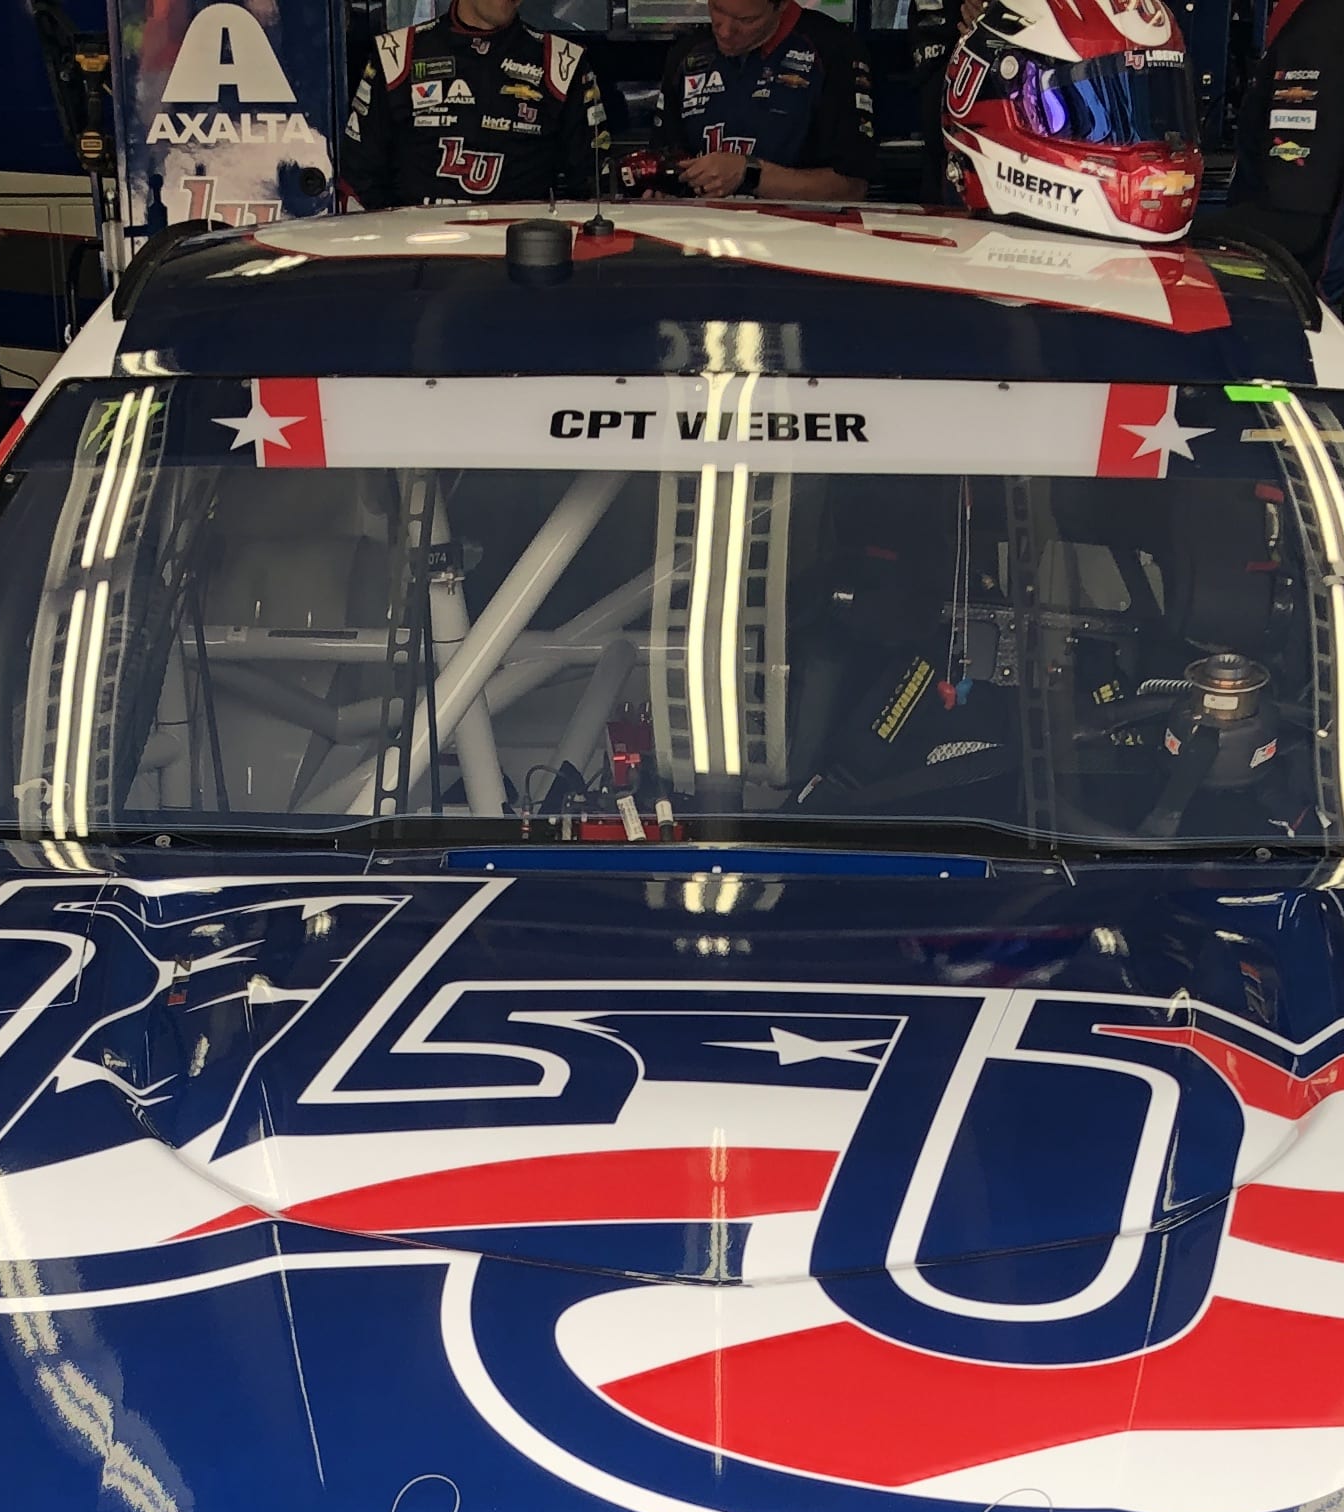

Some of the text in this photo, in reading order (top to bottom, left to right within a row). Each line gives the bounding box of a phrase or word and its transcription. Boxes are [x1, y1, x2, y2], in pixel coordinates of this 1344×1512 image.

[1285, 71, 1320, 80] NASCAR
[146, 113, 314, 144] AXALTA
[436, 136, 504, 195] LU
[997, 161, 1084, 204] LIBERTY
[996, 181, 1080, 217] UNIVERSITY
[549, 410, 870, 442] CPT WEBER
